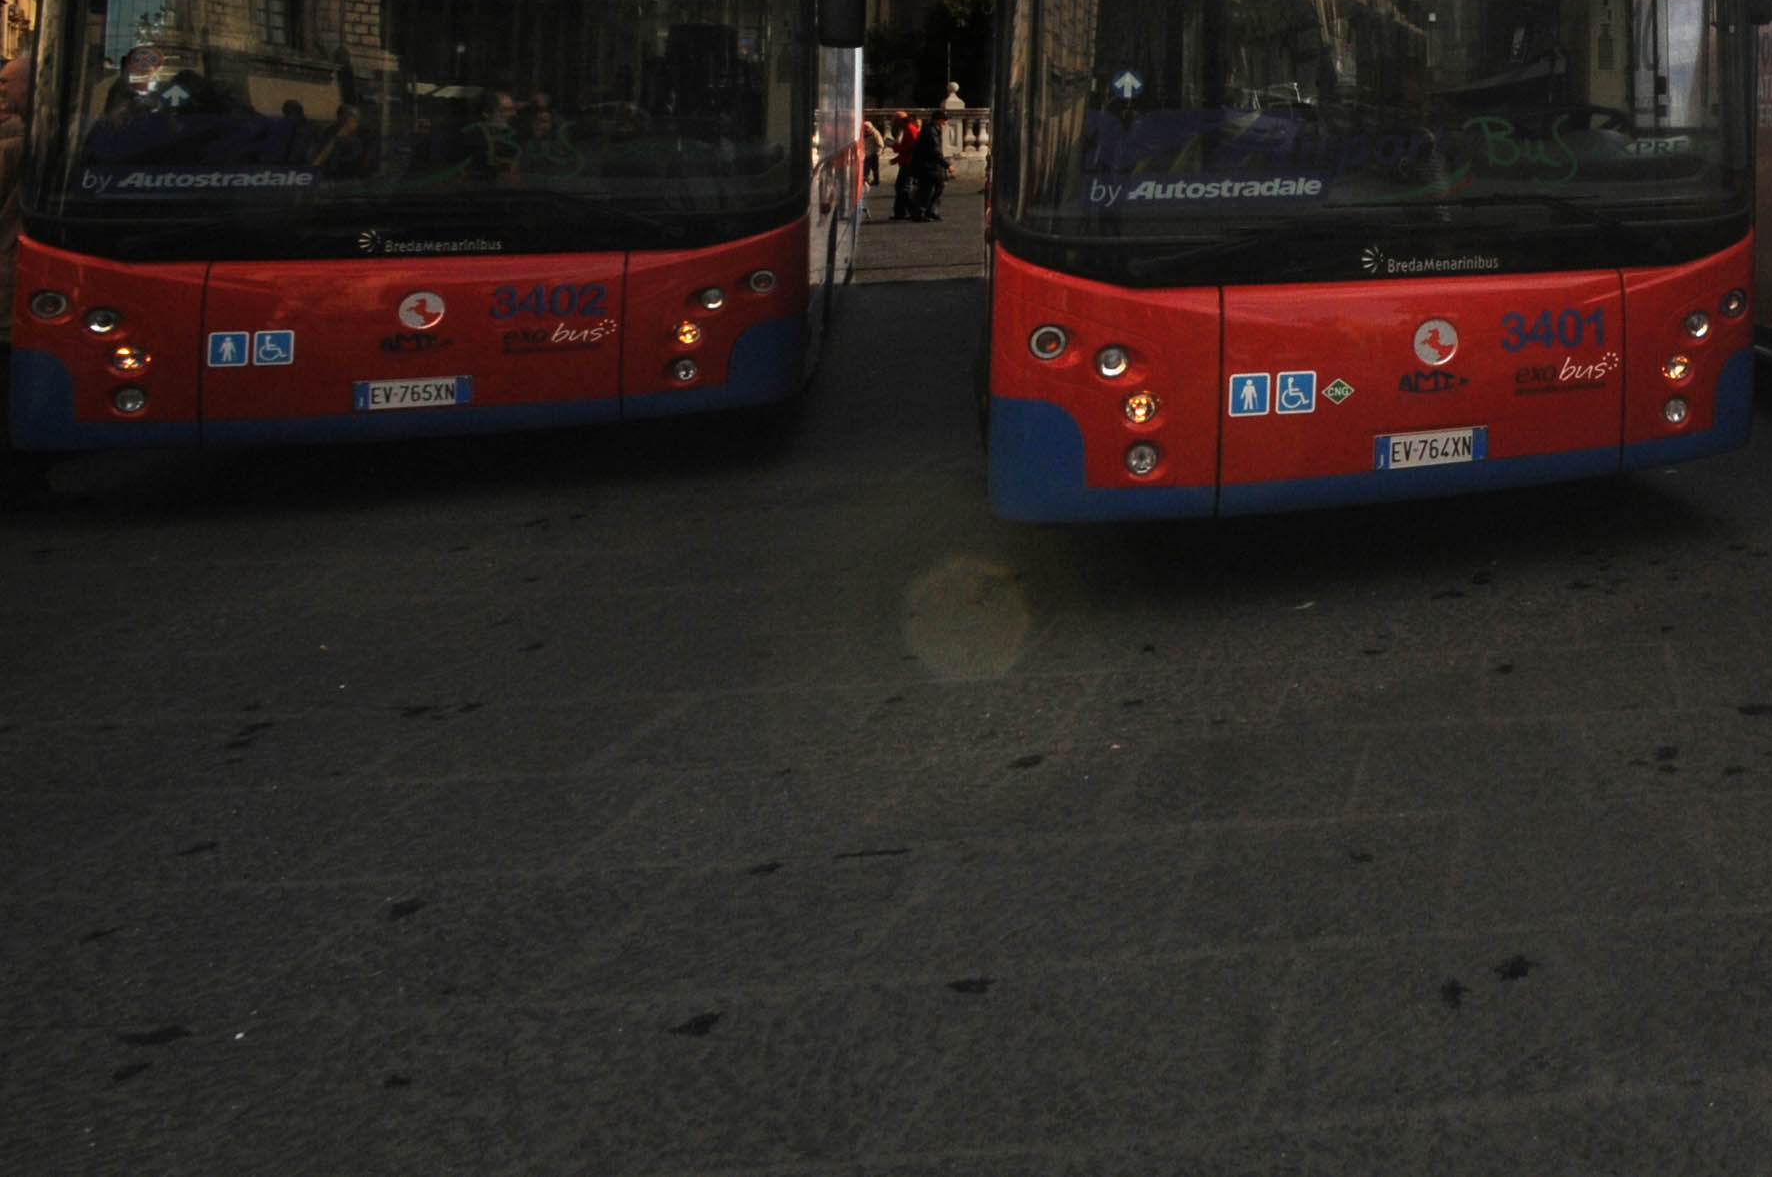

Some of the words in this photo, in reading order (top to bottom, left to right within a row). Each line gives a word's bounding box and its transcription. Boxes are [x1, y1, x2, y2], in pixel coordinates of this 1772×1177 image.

[82, 169, 114, 191] by
[118, 169, 312, 190] Autostradale
[1089, 181, 1122, 204] by
[1128, 177, 1321, 201] Autostradale
[383, 239, 503, 253] BredaMenarinibus
[1386, 255, 1500, 274] BredaMenarinibus
[489, 284, 608, 319] 3402
[1500, 307, 1605, 352] 3401
